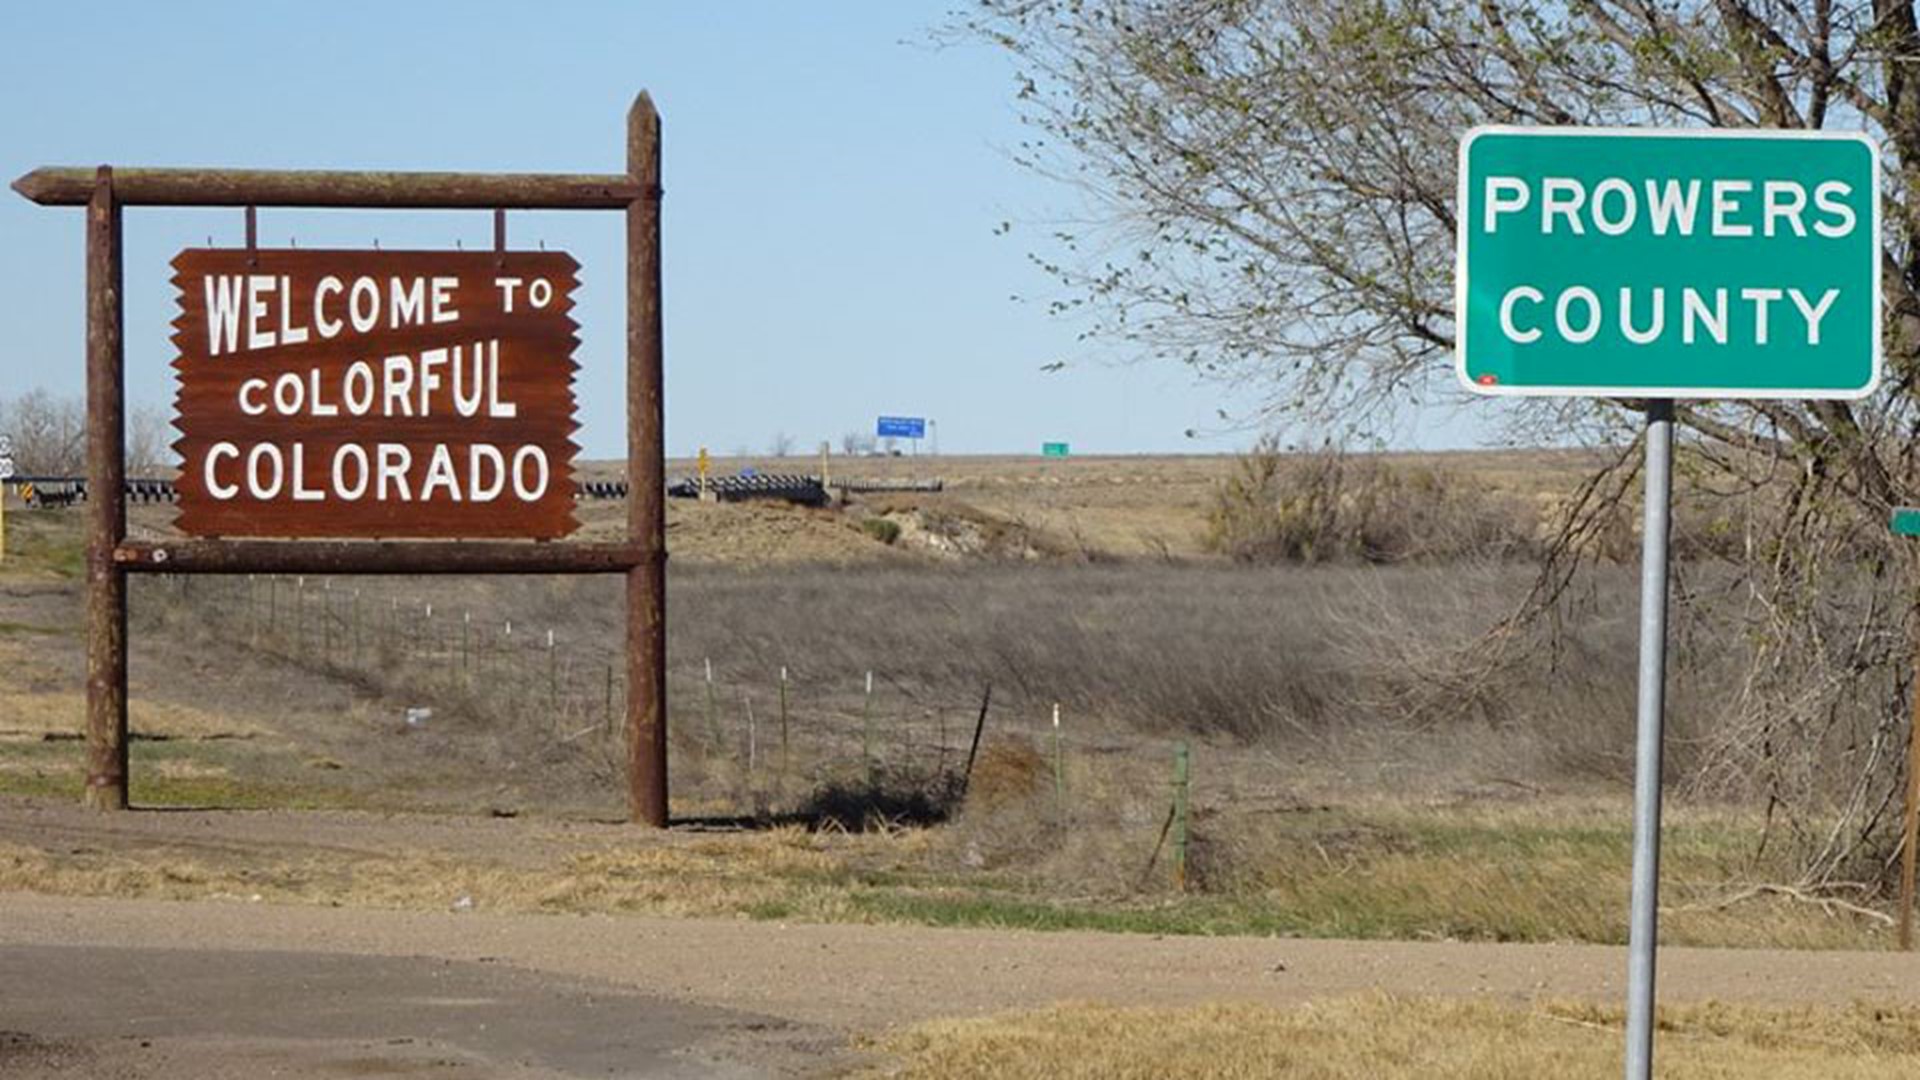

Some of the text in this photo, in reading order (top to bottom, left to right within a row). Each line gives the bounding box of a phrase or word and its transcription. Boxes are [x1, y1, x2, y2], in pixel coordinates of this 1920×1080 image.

[1484, 176, 1857, 238] PROWERS
[204, 274, 552, 356] WELCOME TO
[1500, 286, 1840, 345] COUNTY
[239, 339, 517, 418] COLORFUL
[204, 441, 549, 502] COLORADO
